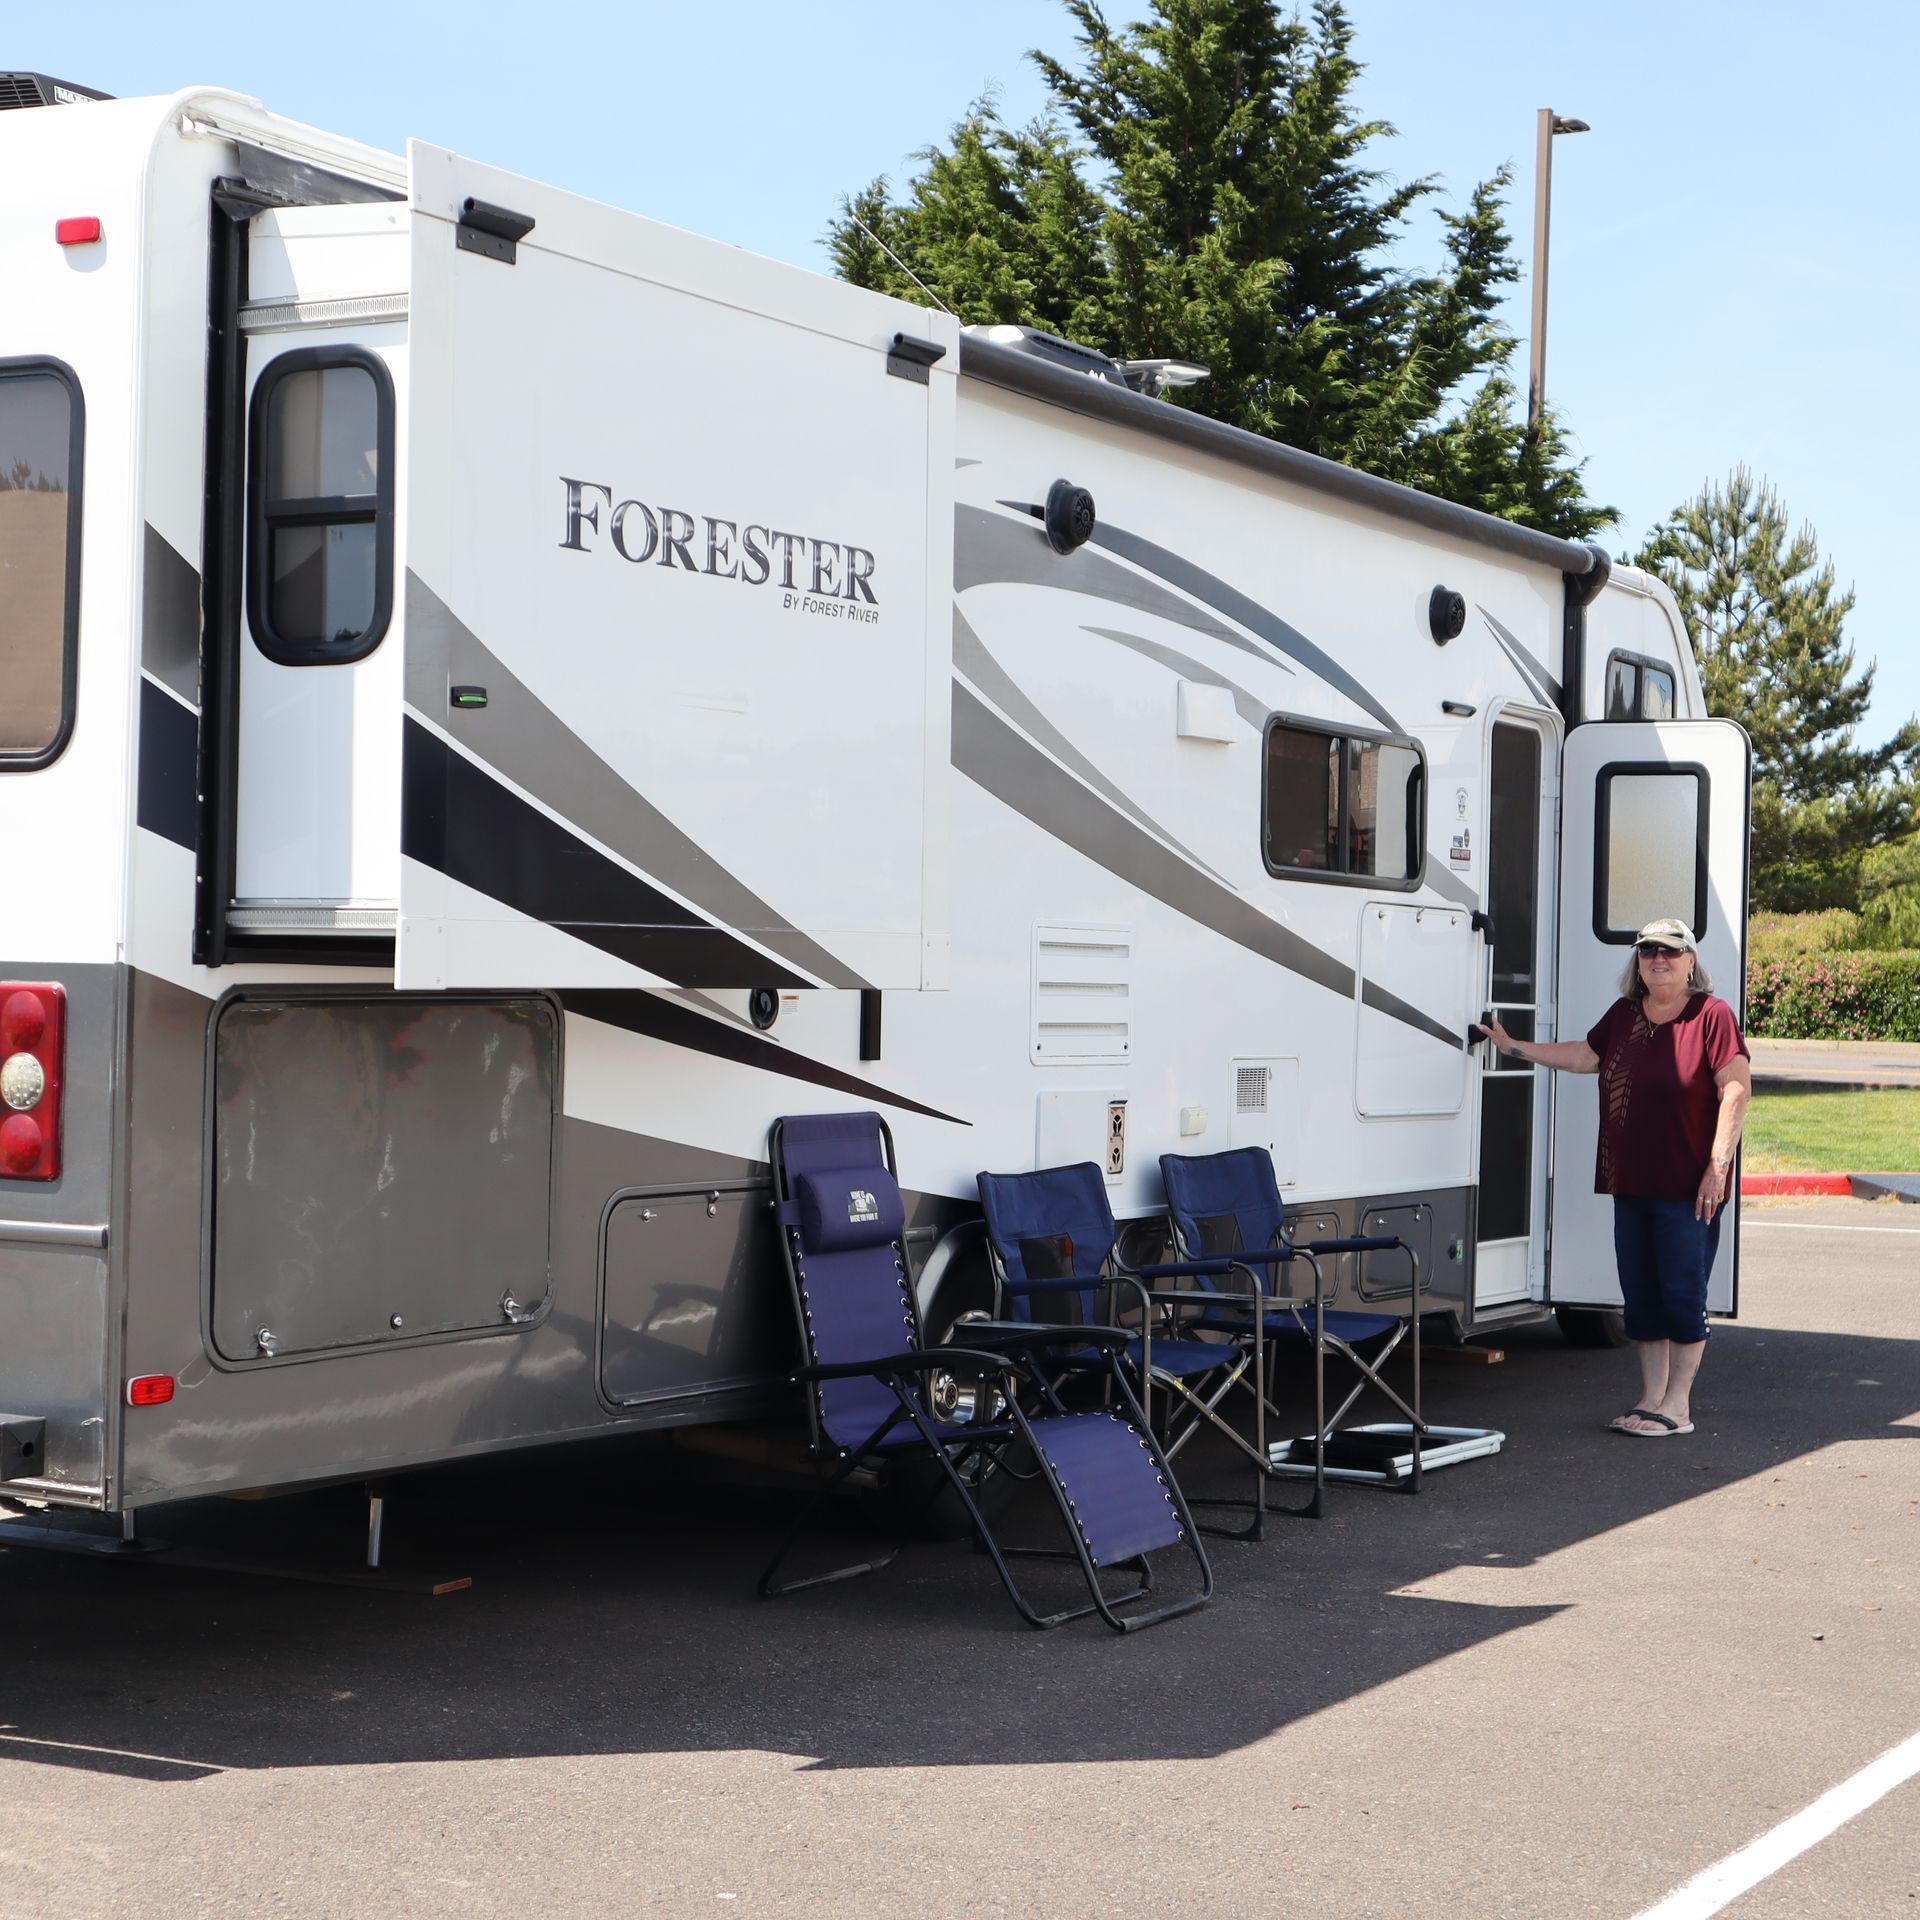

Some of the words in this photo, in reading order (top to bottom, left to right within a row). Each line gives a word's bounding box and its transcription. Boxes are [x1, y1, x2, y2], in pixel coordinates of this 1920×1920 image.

[558, 476, 879, 604] FORESTER
[783, 593, 800, 611] BY
[802, 597, 845, 618] FOREST
[848, 604, 879, 624] RIVER
